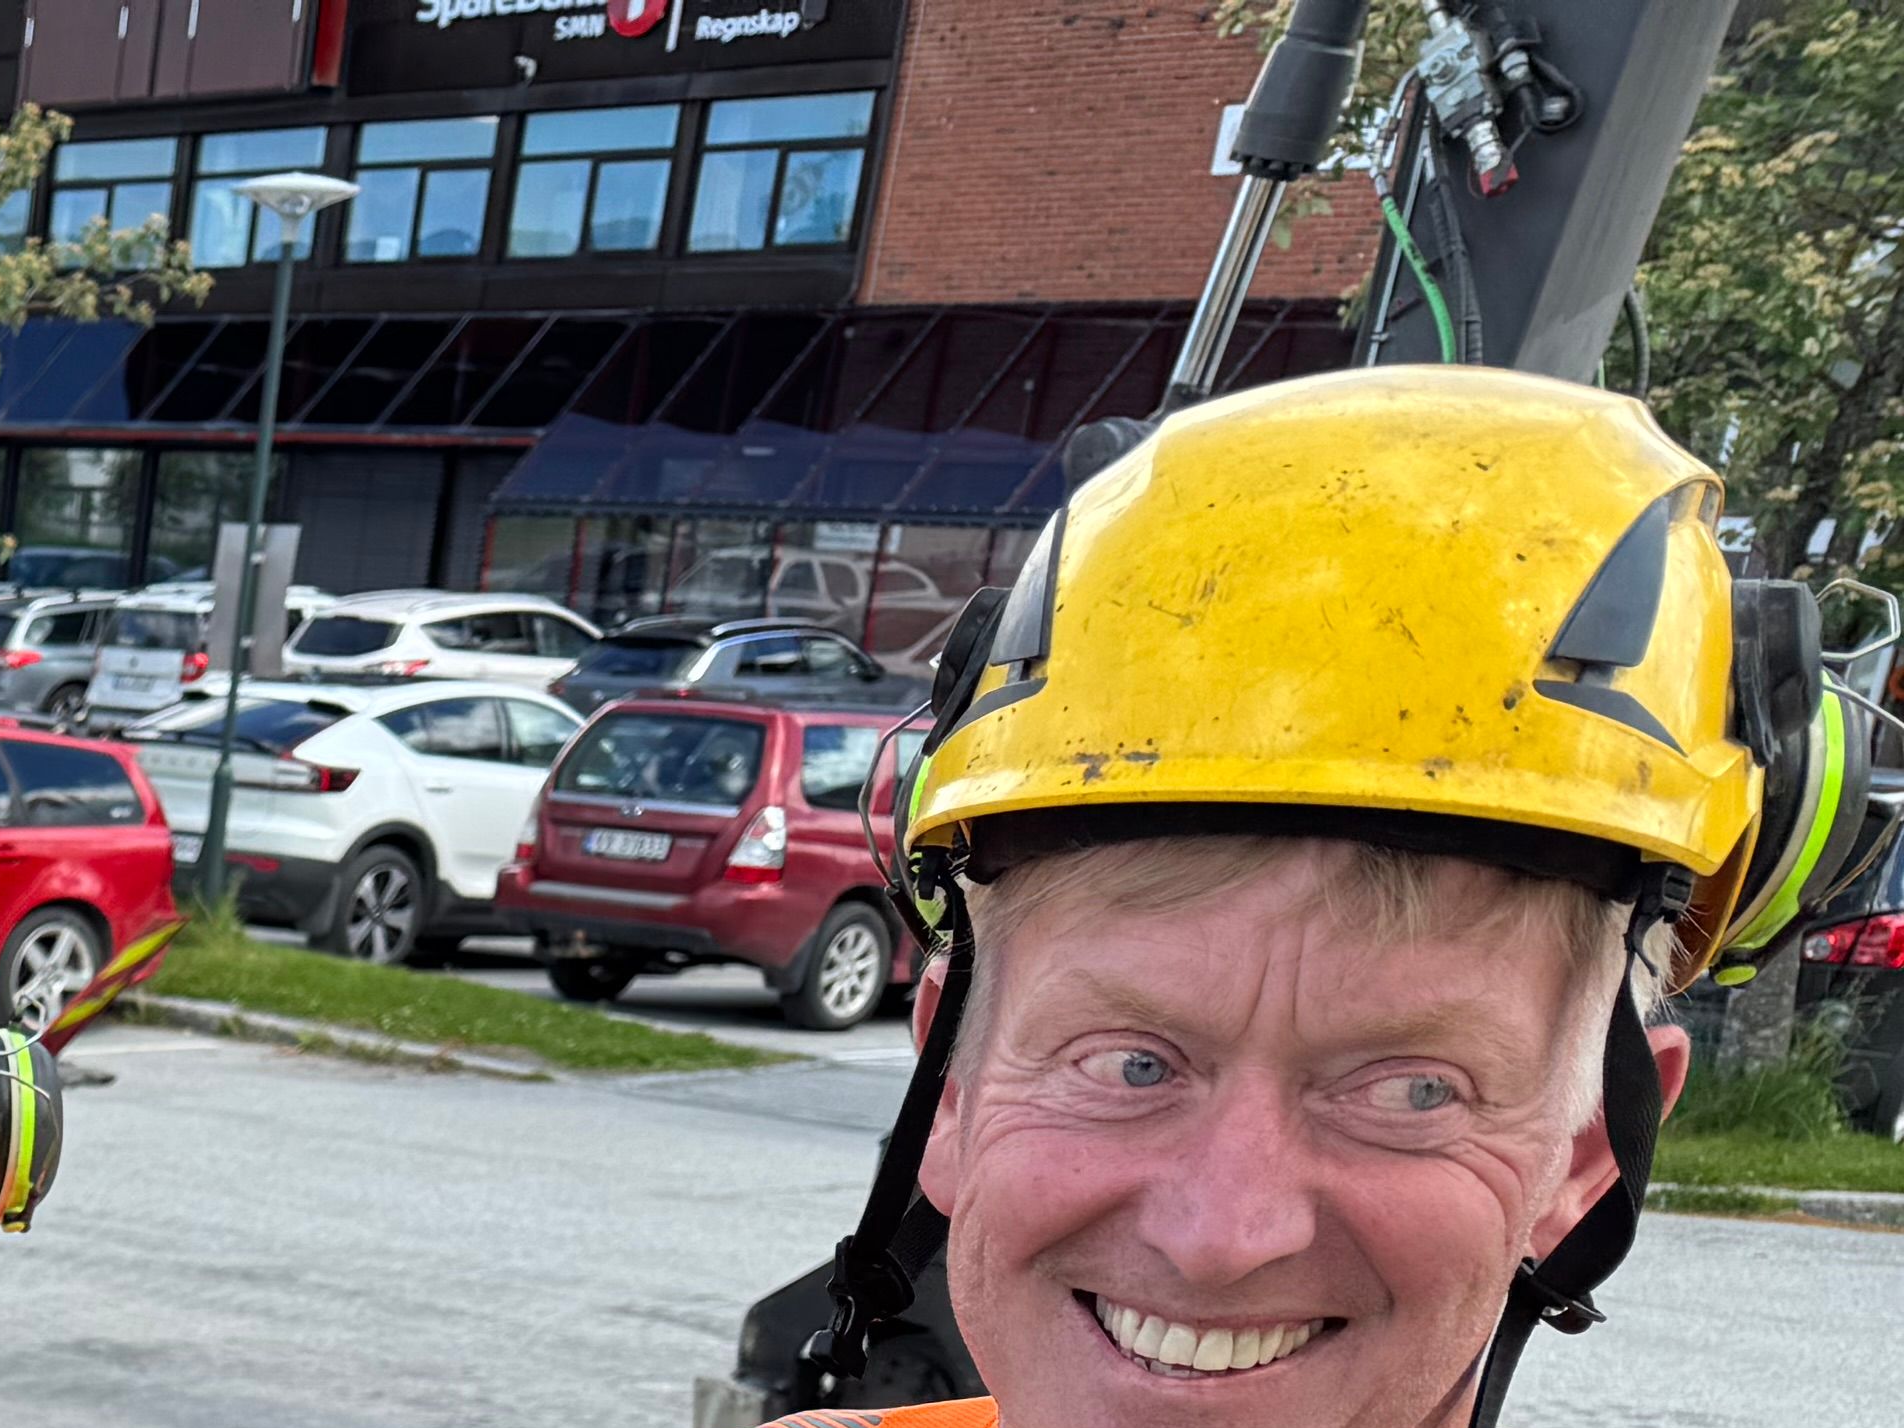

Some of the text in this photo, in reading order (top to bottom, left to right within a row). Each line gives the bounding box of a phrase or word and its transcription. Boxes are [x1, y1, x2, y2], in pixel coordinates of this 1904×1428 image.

[416, 0, 608, 29] Spare
[553, 13, 607, 41] SMN
[695, 9, 800, 43] Regnskap
